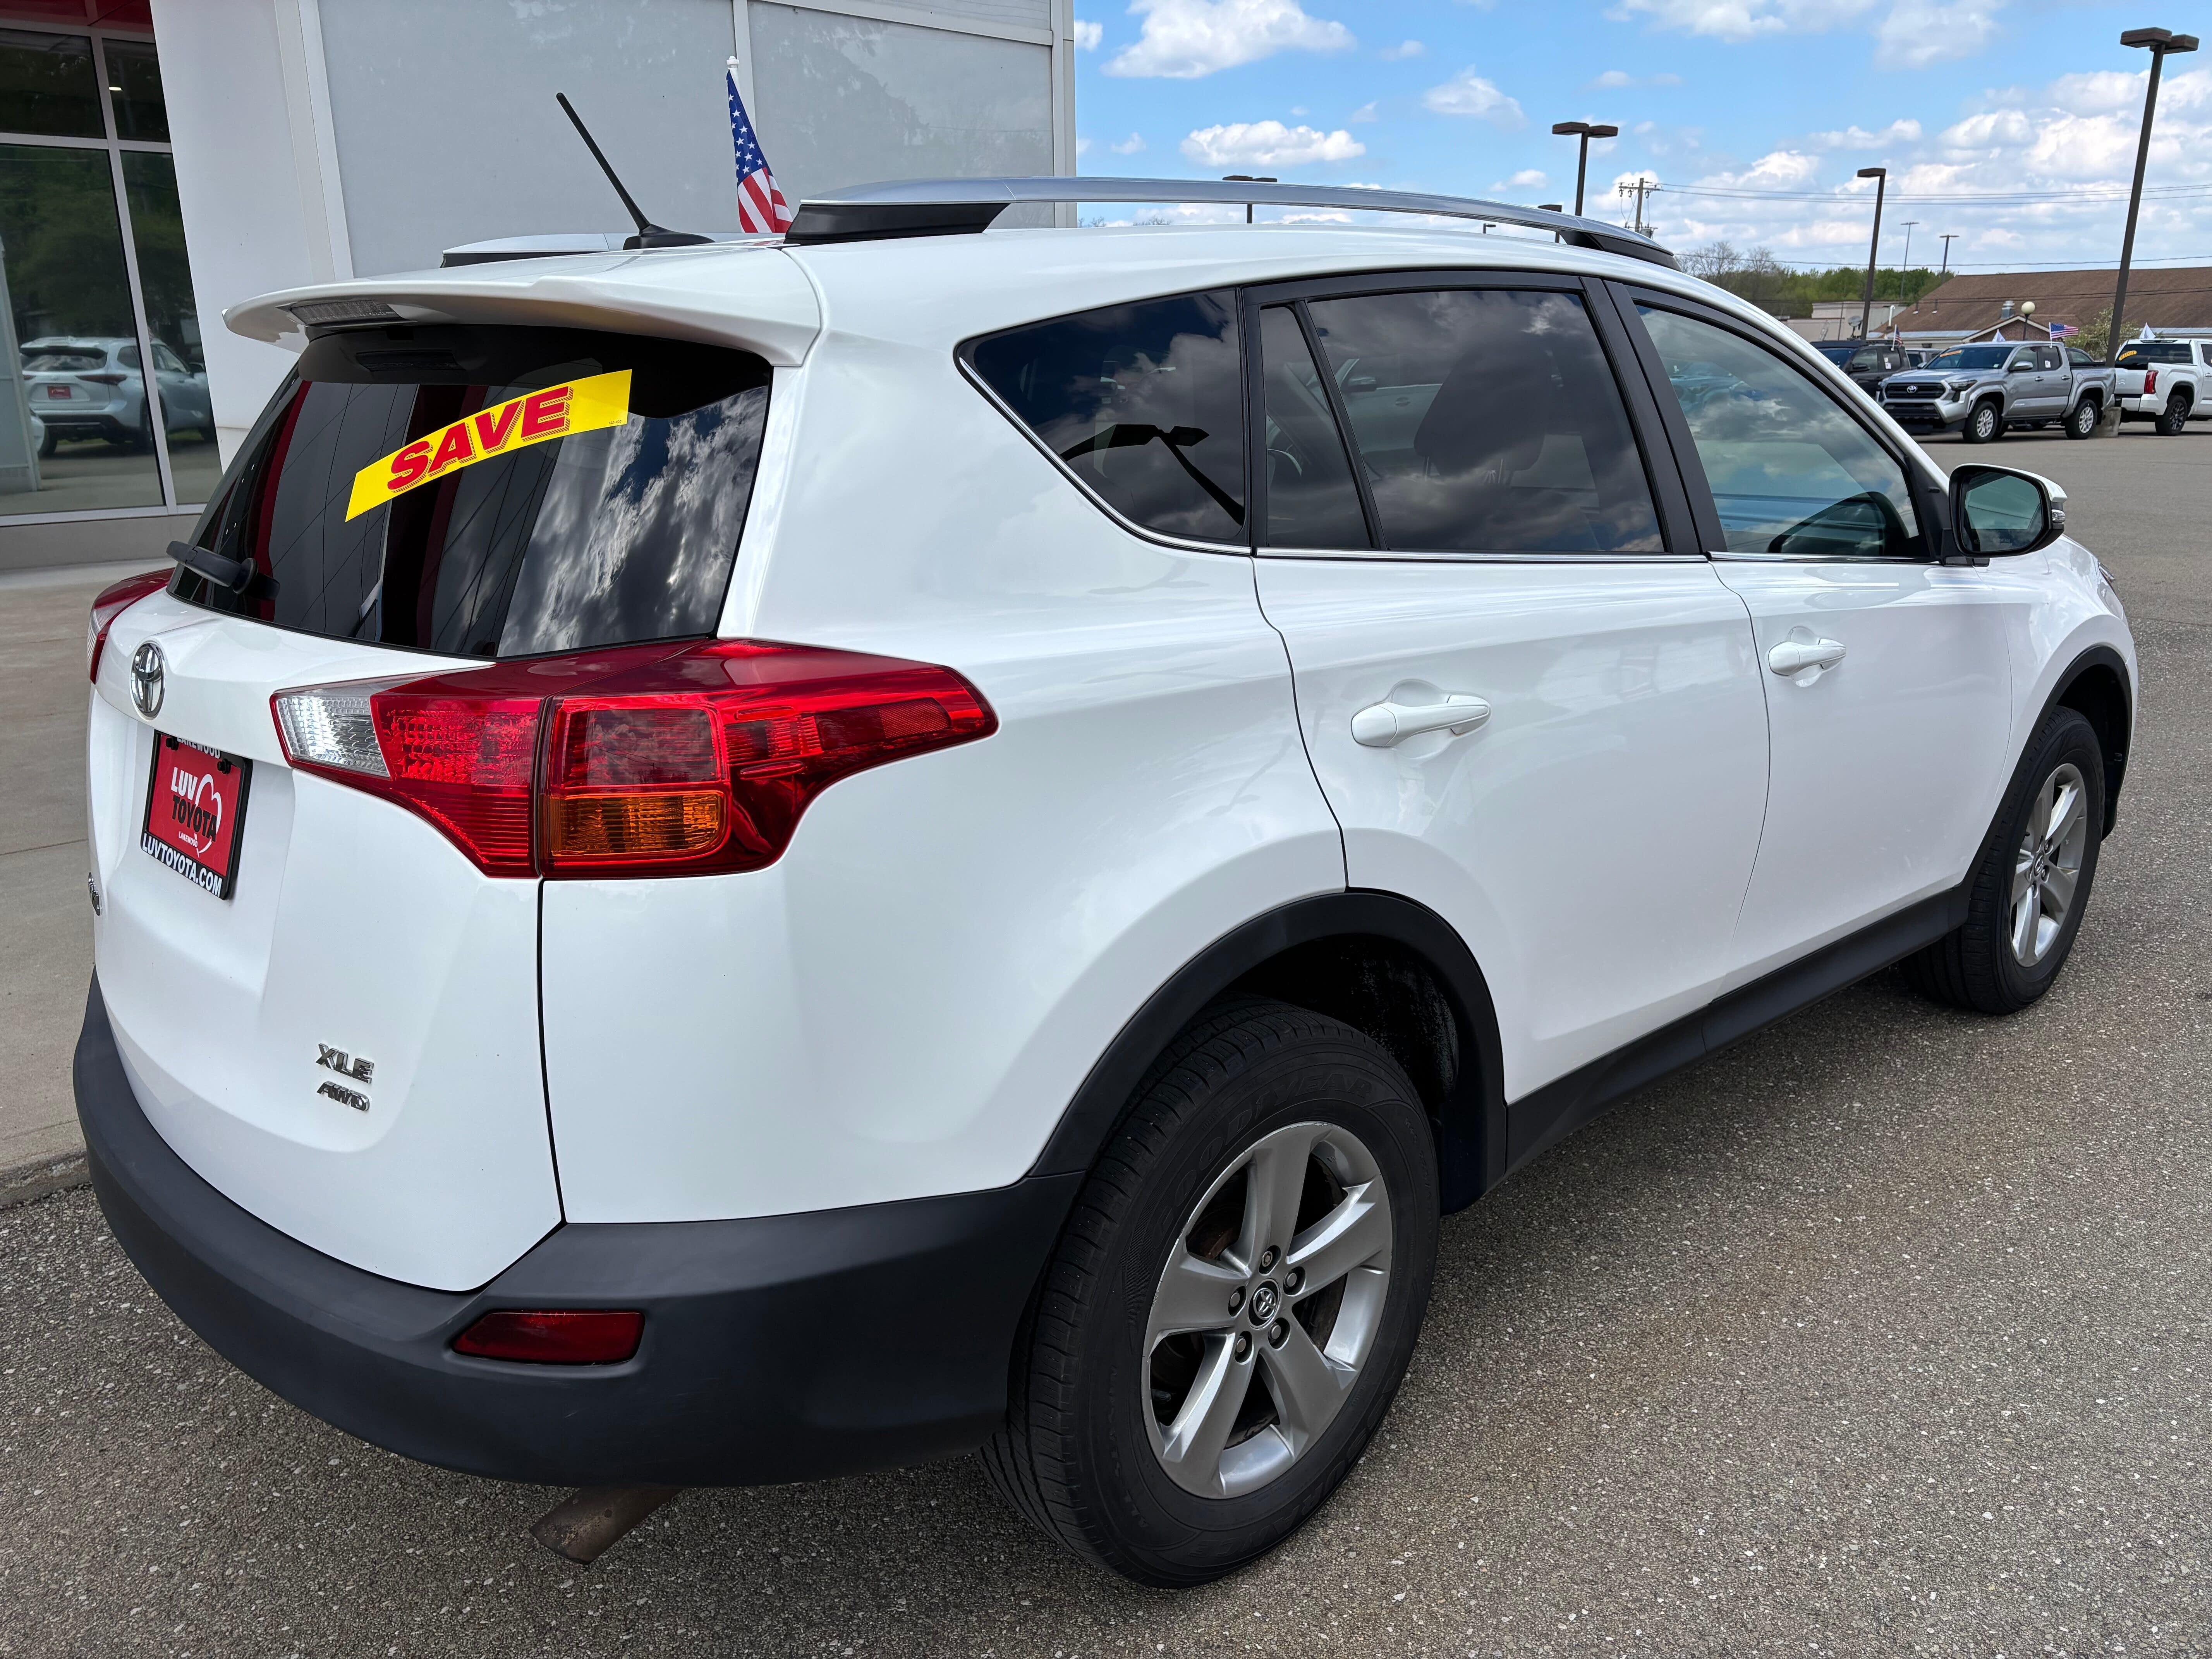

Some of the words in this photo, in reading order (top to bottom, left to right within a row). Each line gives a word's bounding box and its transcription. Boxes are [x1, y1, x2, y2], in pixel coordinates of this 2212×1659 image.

[387, 386, 574, 493] SAVE
[171, 767, 198, 800] LUV
[172, 794, 217, 842] TOYOTA
[179, 831, 198, 848] LAKEWOOD
[142, 833, 222, 897] LUVTOYOTA.COM
[316, 1043, 374, 1084] XLE
[316, 1081, 370, 1111] AWD
[1152, 1073, 1372, 1249] GOODYEAR
